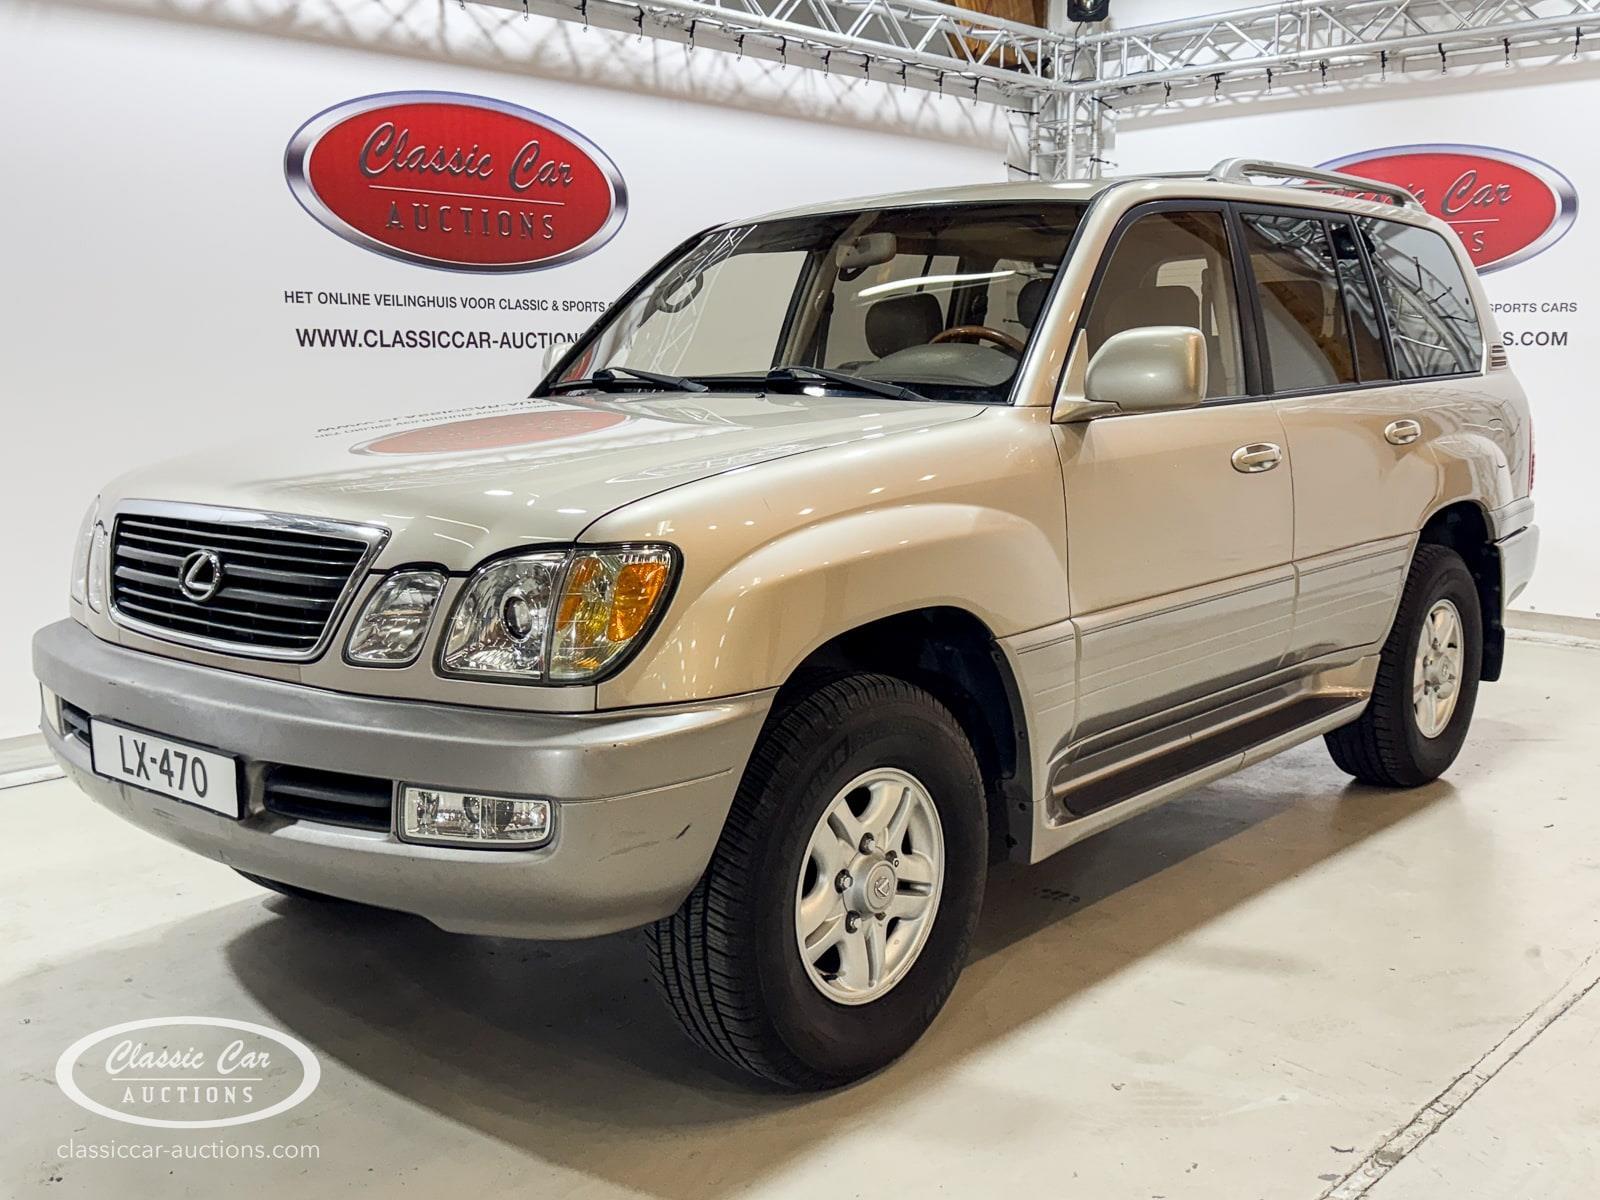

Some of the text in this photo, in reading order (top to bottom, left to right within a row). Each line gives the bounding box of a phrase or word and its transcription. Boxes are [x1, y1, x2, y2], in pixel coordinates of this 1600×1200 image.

[358, 121, 574, 191] Classic Car
[1441, 169, 1512, 215] Car
[385, 200, 555, 240] AUCTIONS
[284, 290, 313, 304] HET
[317, 291, 371, 306] ONLINE
[374, 293, 458, 309] VEILINGHUIS
[460, 296, 496, 310] VOOR
[499, 298, 549, 312] CLASSIC
[552, 300, 560, 312] &
[562, 300, 606, 313] SPORTS
[1541, 302, 1578, 313] CARS
[295, 328, 584, 350] WWW.CLASSICCAR-AUCTION
[119, 735, 208, 798] LX-470
